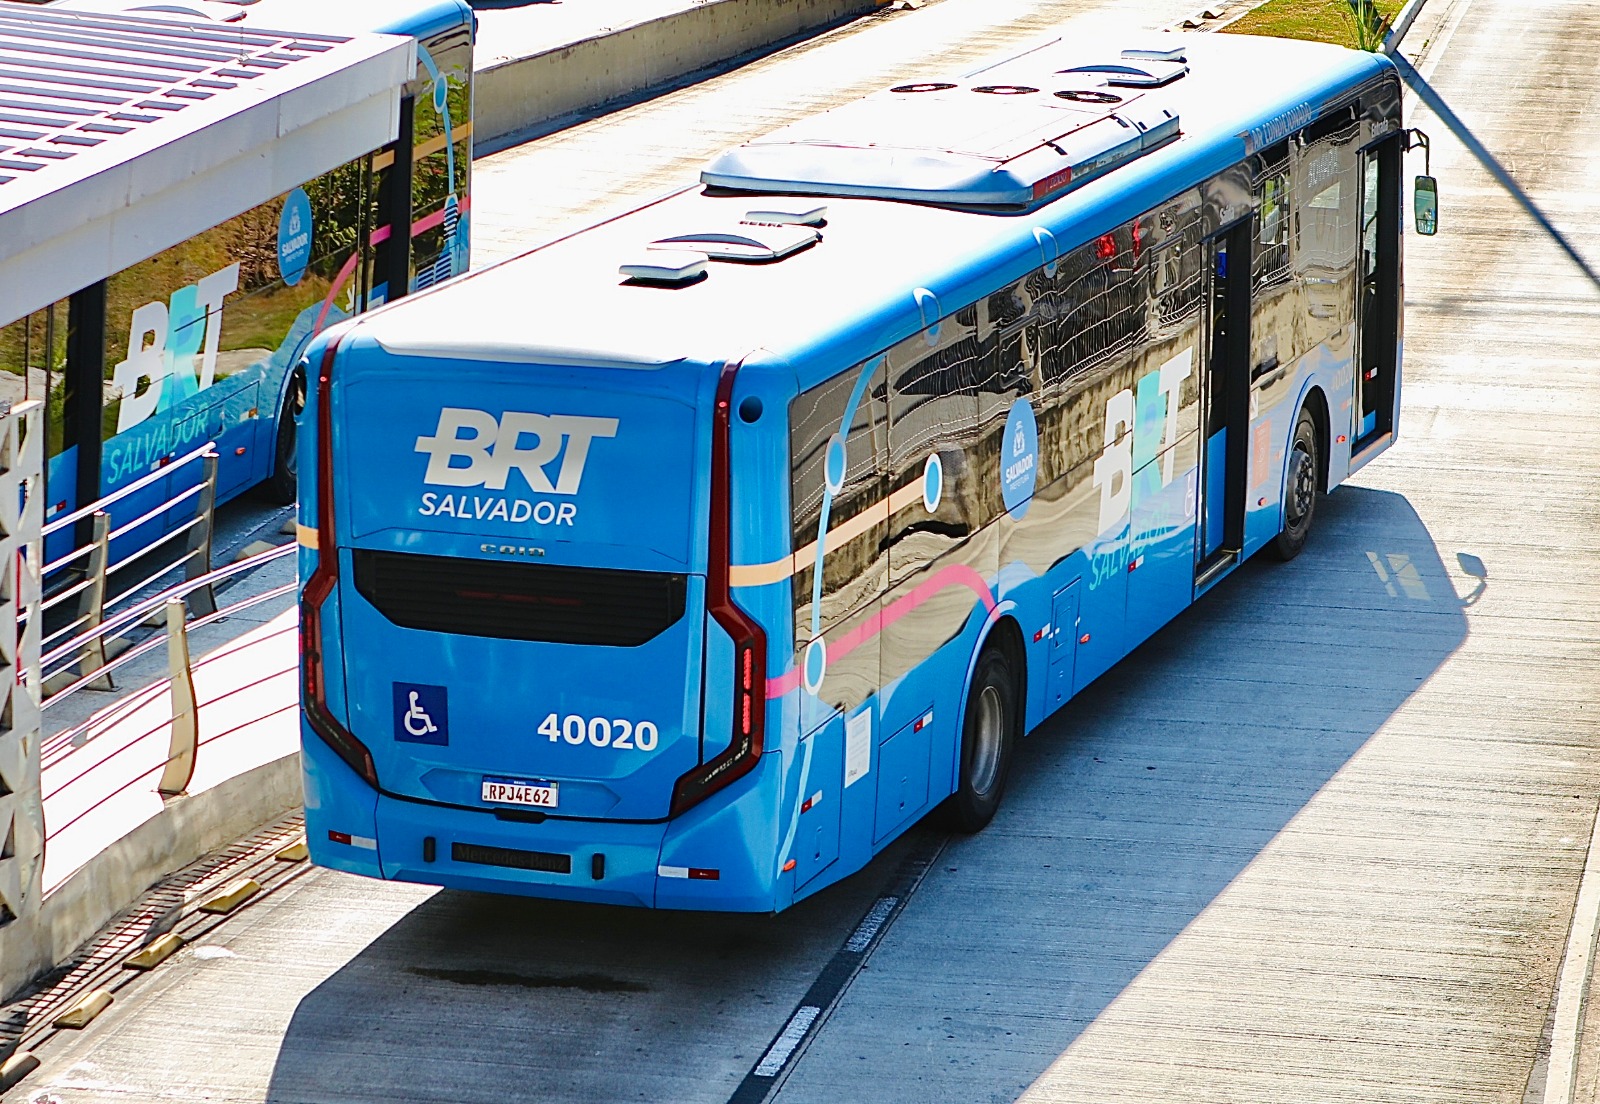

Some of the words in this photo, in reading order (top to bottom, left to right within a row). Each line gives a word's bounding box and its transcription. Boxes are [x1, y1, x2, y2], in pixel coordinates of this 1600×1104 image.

[1371, 117, 1389, 139] Entrada
[281, 232, 308, 257] SALVADOR
[113, 262, 240, 434] BRT
[107, 402, 210, 484] SALVADOR
[414, 407, 620, 496] BRT
[1093, 345, 1192, 537] BRT
[1006, 453, 1033, 484] SALVADOR
[418, 492, 577, 526] SALVADOR
[537, 713, 659, 751] 40020
[489, 784, 550, 805] RPJ4E62
